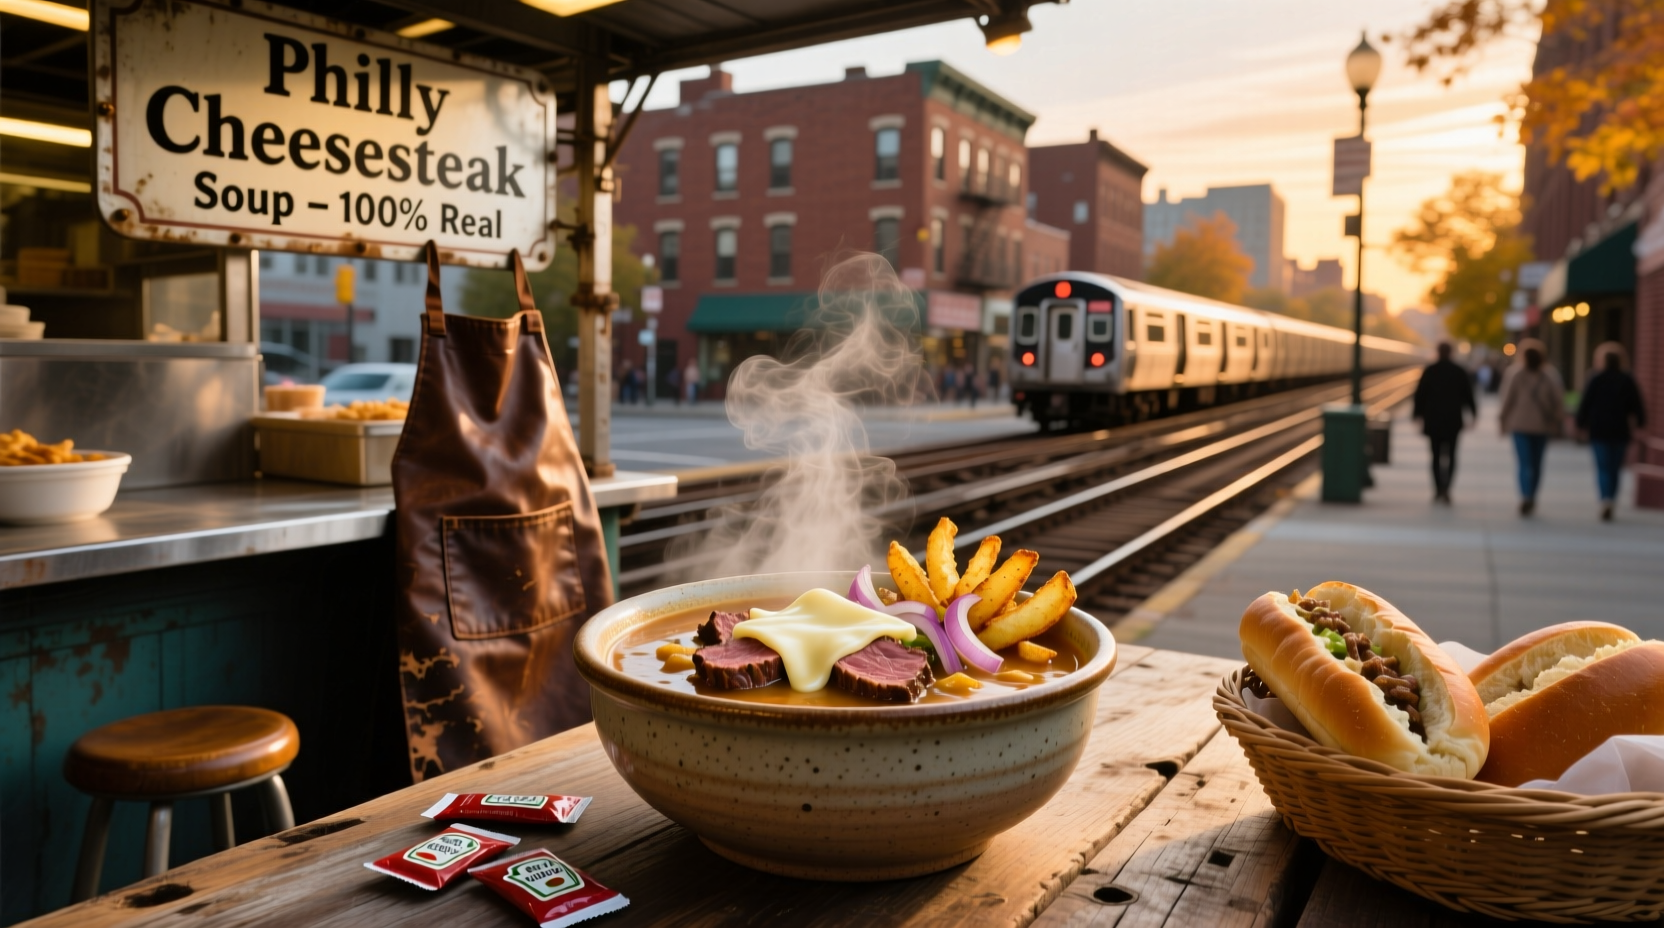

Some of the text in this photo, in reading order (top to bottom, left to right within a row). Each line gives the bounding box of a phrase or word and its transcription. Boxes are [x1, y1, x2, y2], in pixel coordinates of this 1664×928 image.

[264, 33, 449, 136] Philly
[146, 85, 525, 198] Cheesesteak
[194, 171, 294, 225] Soup
[339, 192, 427, 231] 100%
[441, 204, 502, 239] Real
